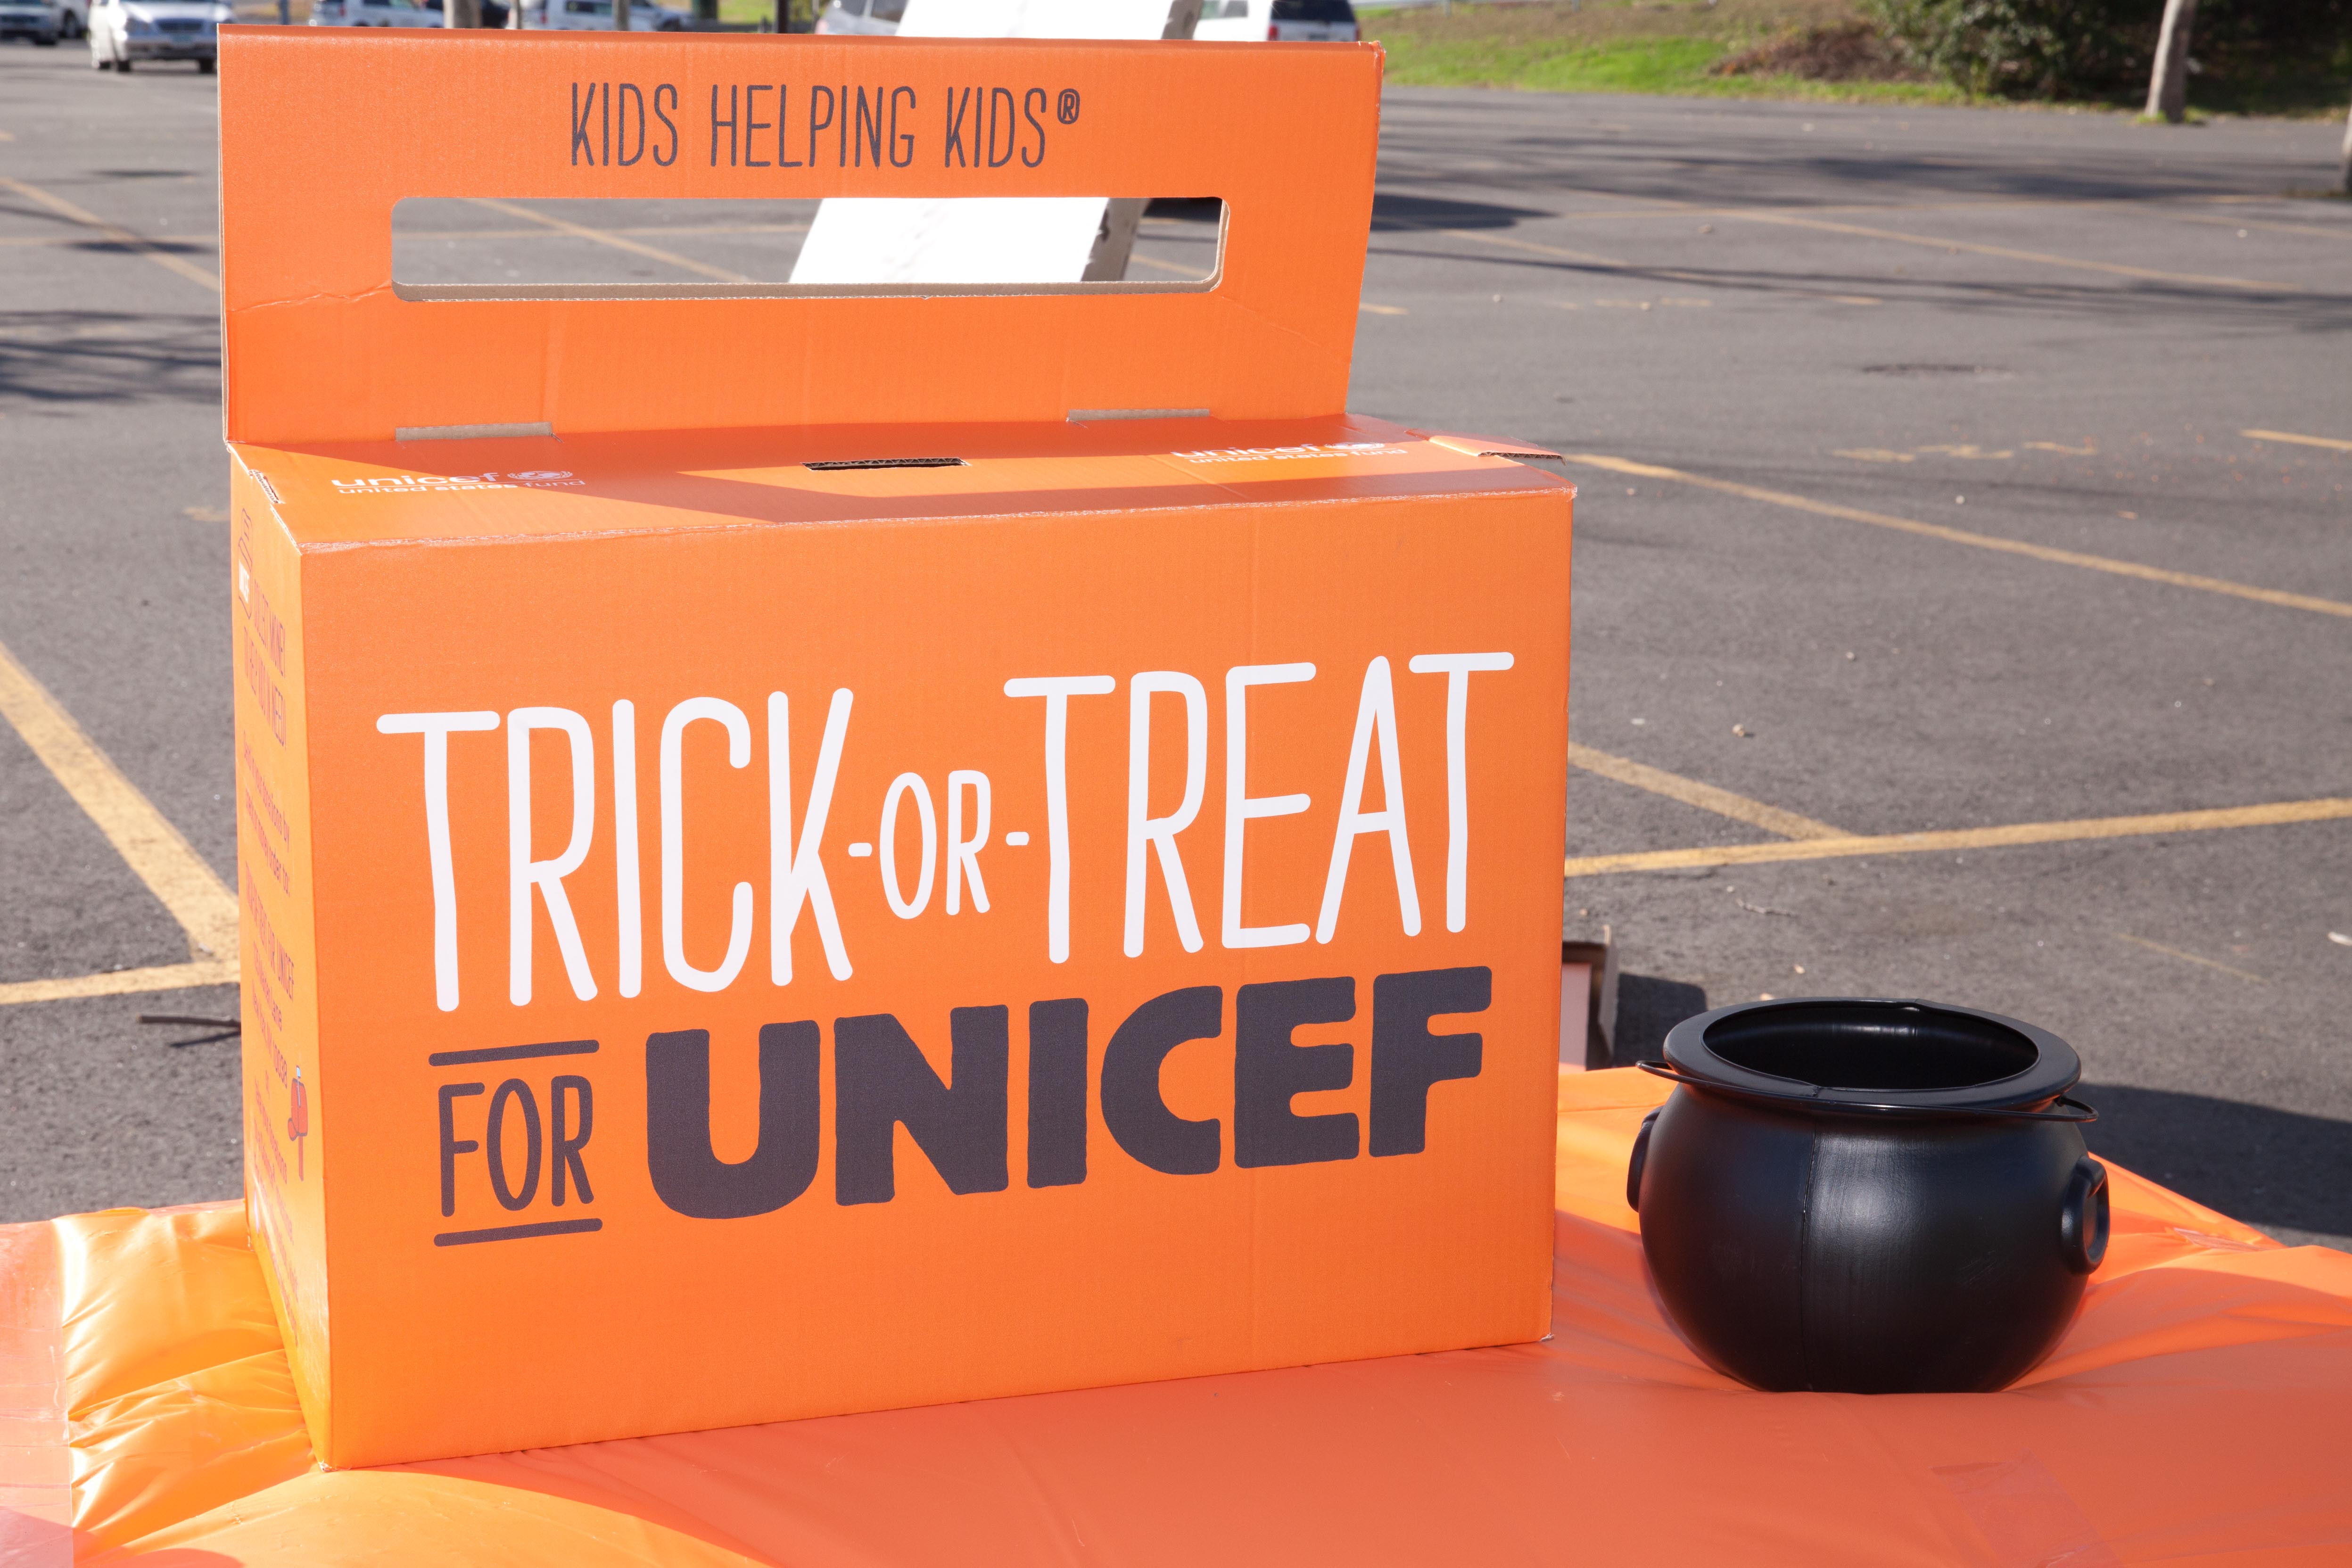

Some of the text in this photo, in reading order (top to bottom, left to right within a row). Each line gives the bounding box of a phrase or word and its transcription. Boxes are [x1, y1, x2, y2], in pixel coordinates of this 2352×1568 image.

[571, 83, 678, 167] KIDS
[710, 84, 916, 168] HELPING
[1171, 444, 1320, 458] unicef
[1189, 454, 1268, 463] united
[1273, 452, 1348, 461] states
[331, 472, 501, 487] unicef
[338, 479, 586, 494] united states fund
[438, 1074, 594, 1217] FOR
[646, 965, 1493, 1220] UNICEF
